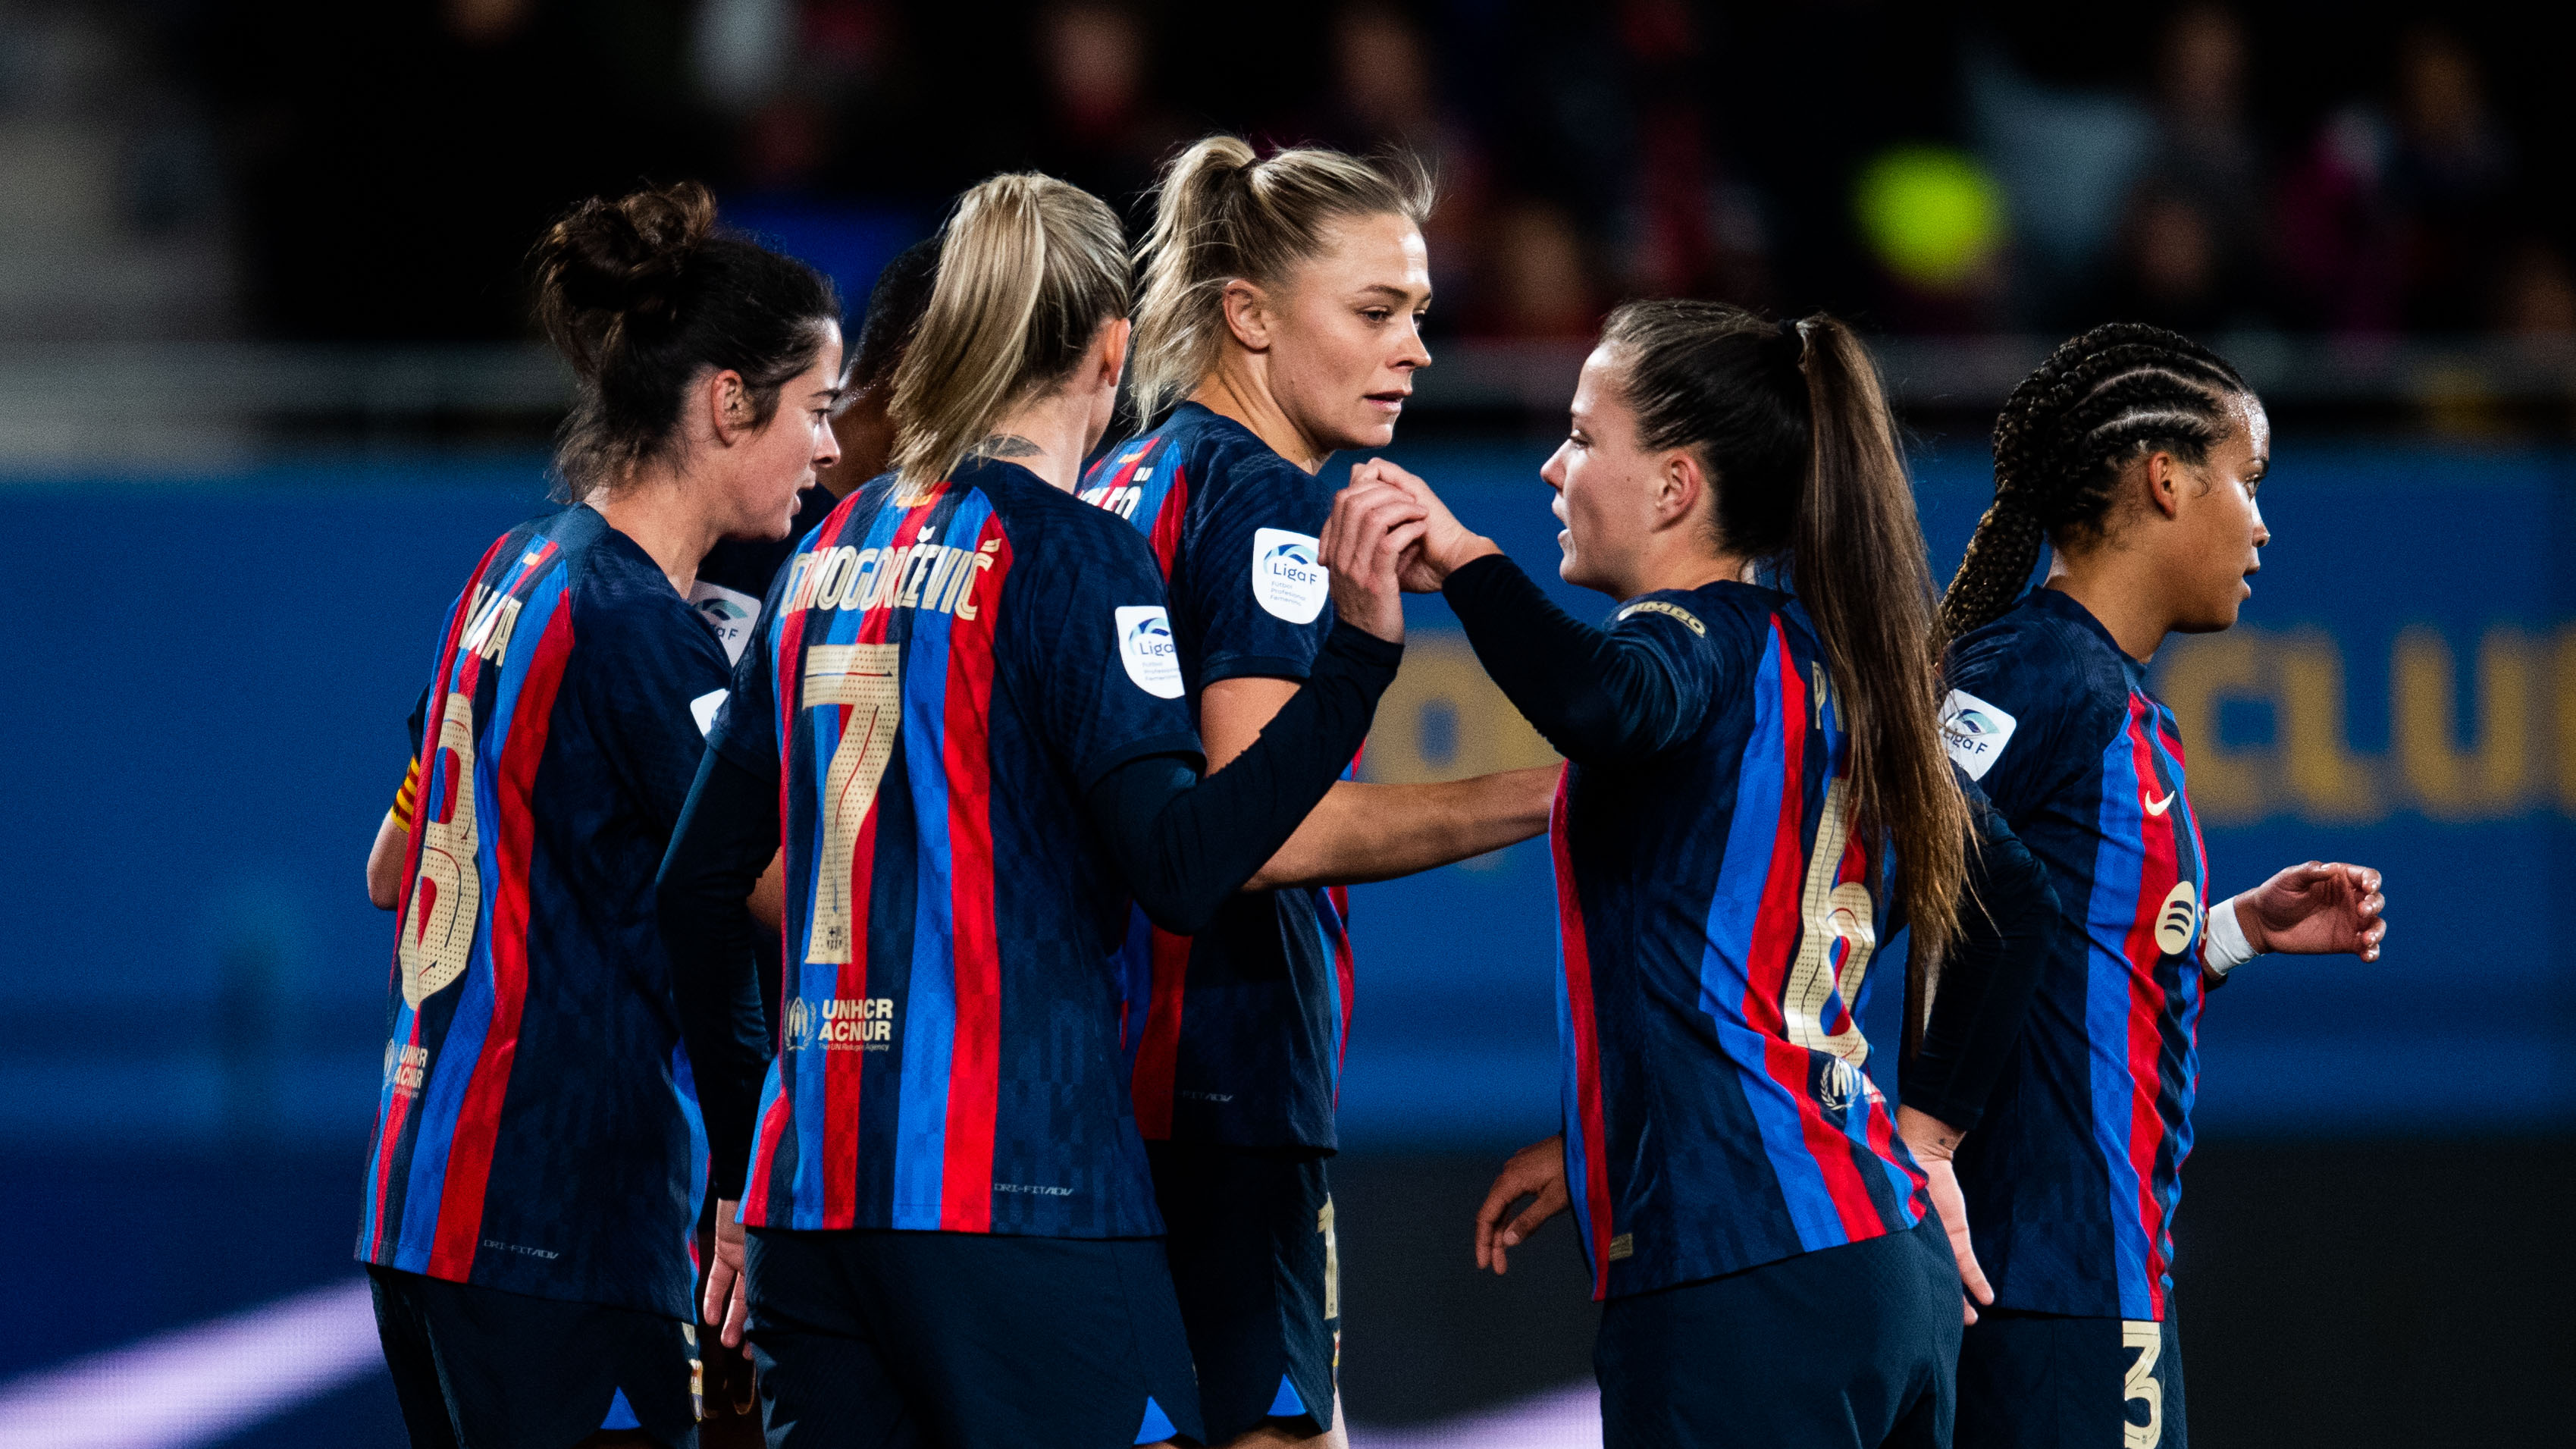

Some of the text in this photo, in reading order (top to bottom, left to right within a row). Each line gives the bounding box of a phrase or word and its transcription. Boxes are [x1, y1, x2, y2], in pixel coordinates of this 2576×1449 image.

[1274, 563, 1318, 585] Liga F
[1139, 641, 1174, 657] Liga
[2162, 623, 2576, 826] CLU
[399, 692, 481, 1011] 8
[802, 643, 901, 964] 7
[1784, 776, 1876, 1069] 6
[817, 1021, 892, 1042] ACNUR
[821, 998, 894, 1020] UNHCR
[2122, 1320, 2162, 1449] 3
